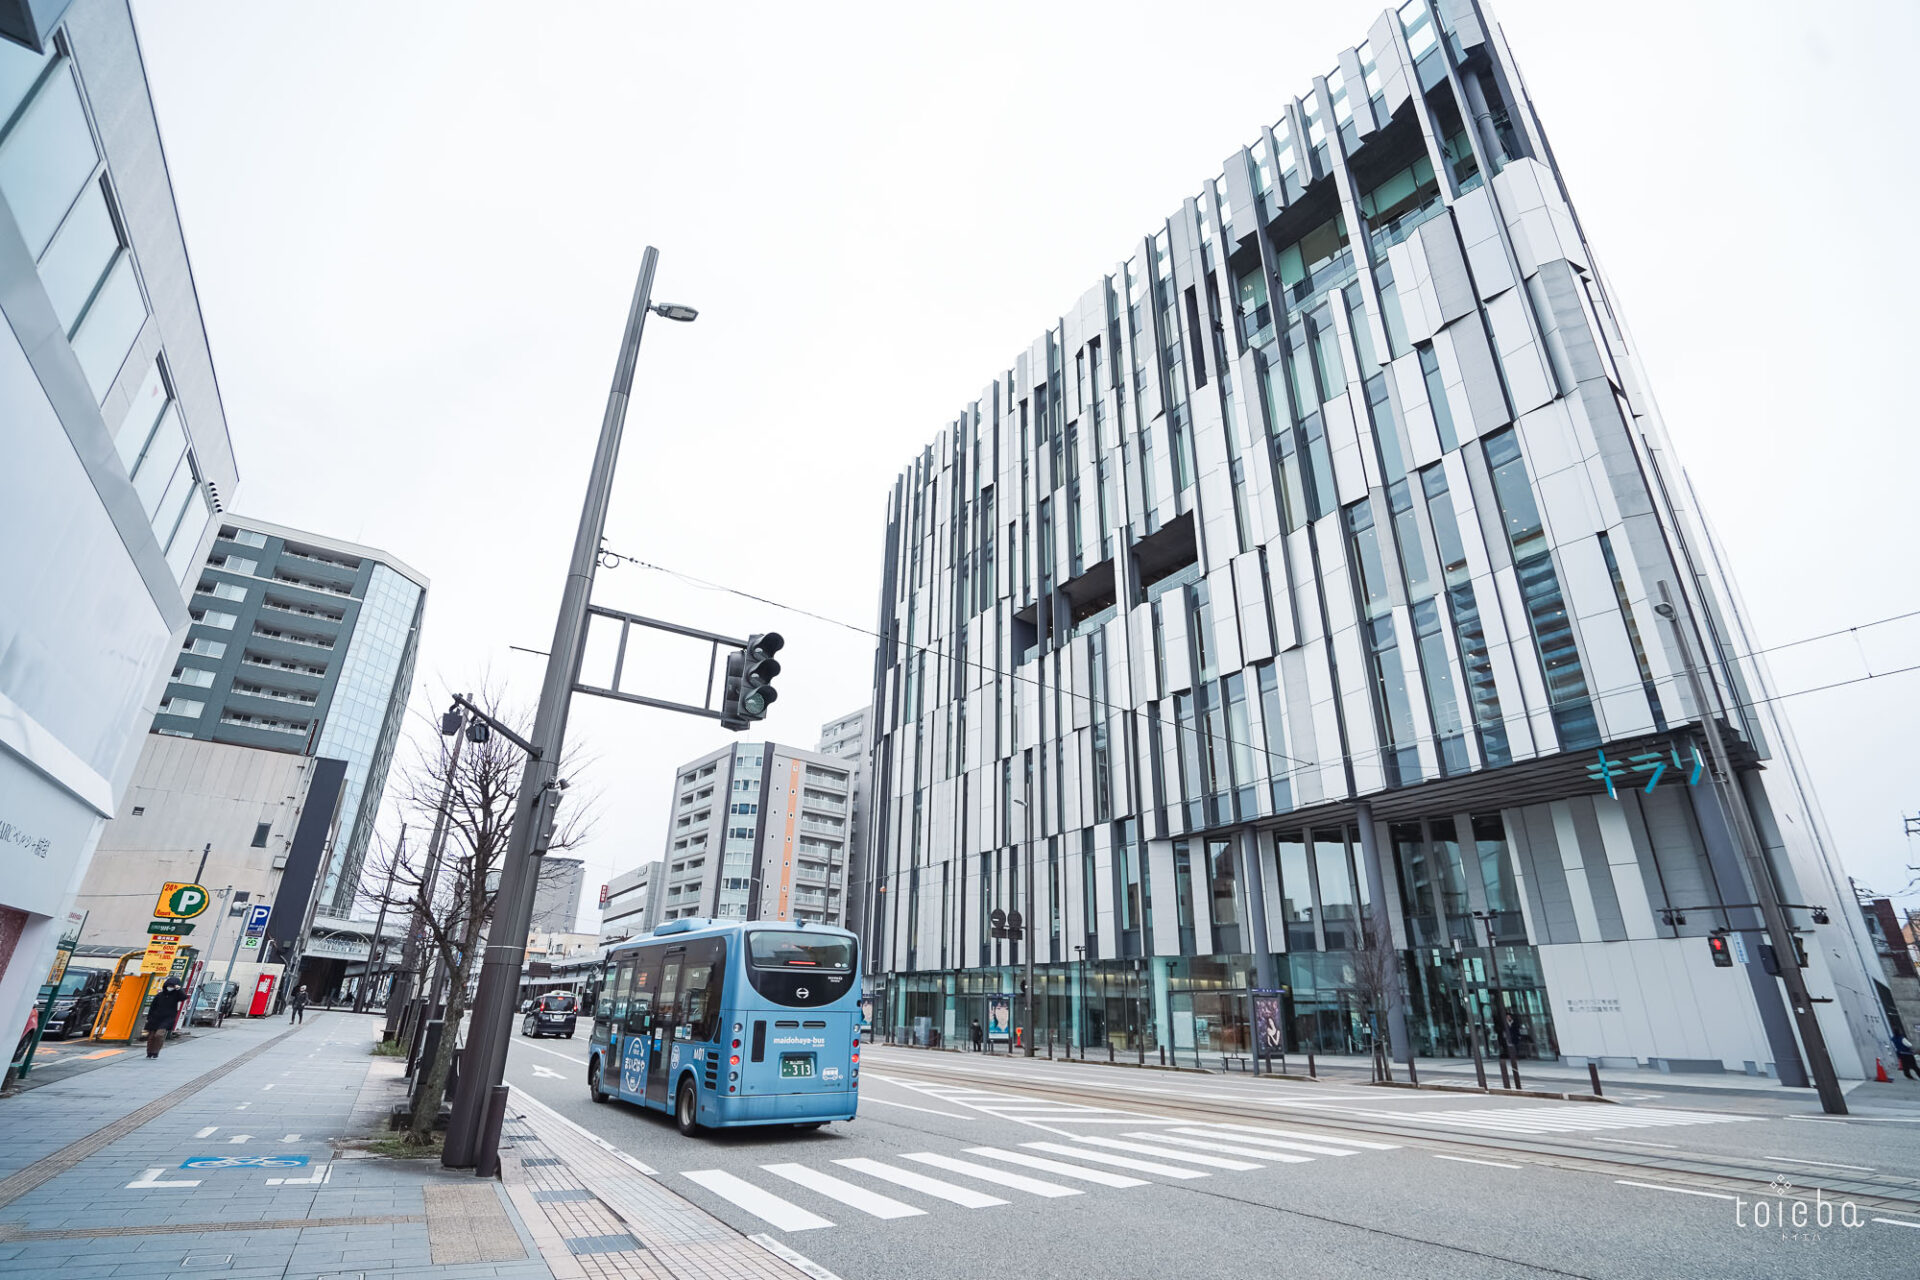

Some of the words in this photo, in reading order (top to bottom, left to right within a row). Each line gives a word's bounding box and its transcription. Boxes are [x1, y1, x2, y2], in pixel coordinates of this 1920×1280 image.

[1585, 749, 1704, 800] キラリ
[178, 891, 202, 912] P
[251, 908, 268, 924] P
[773, 1036, 825, 1046] maidohaya-bus
